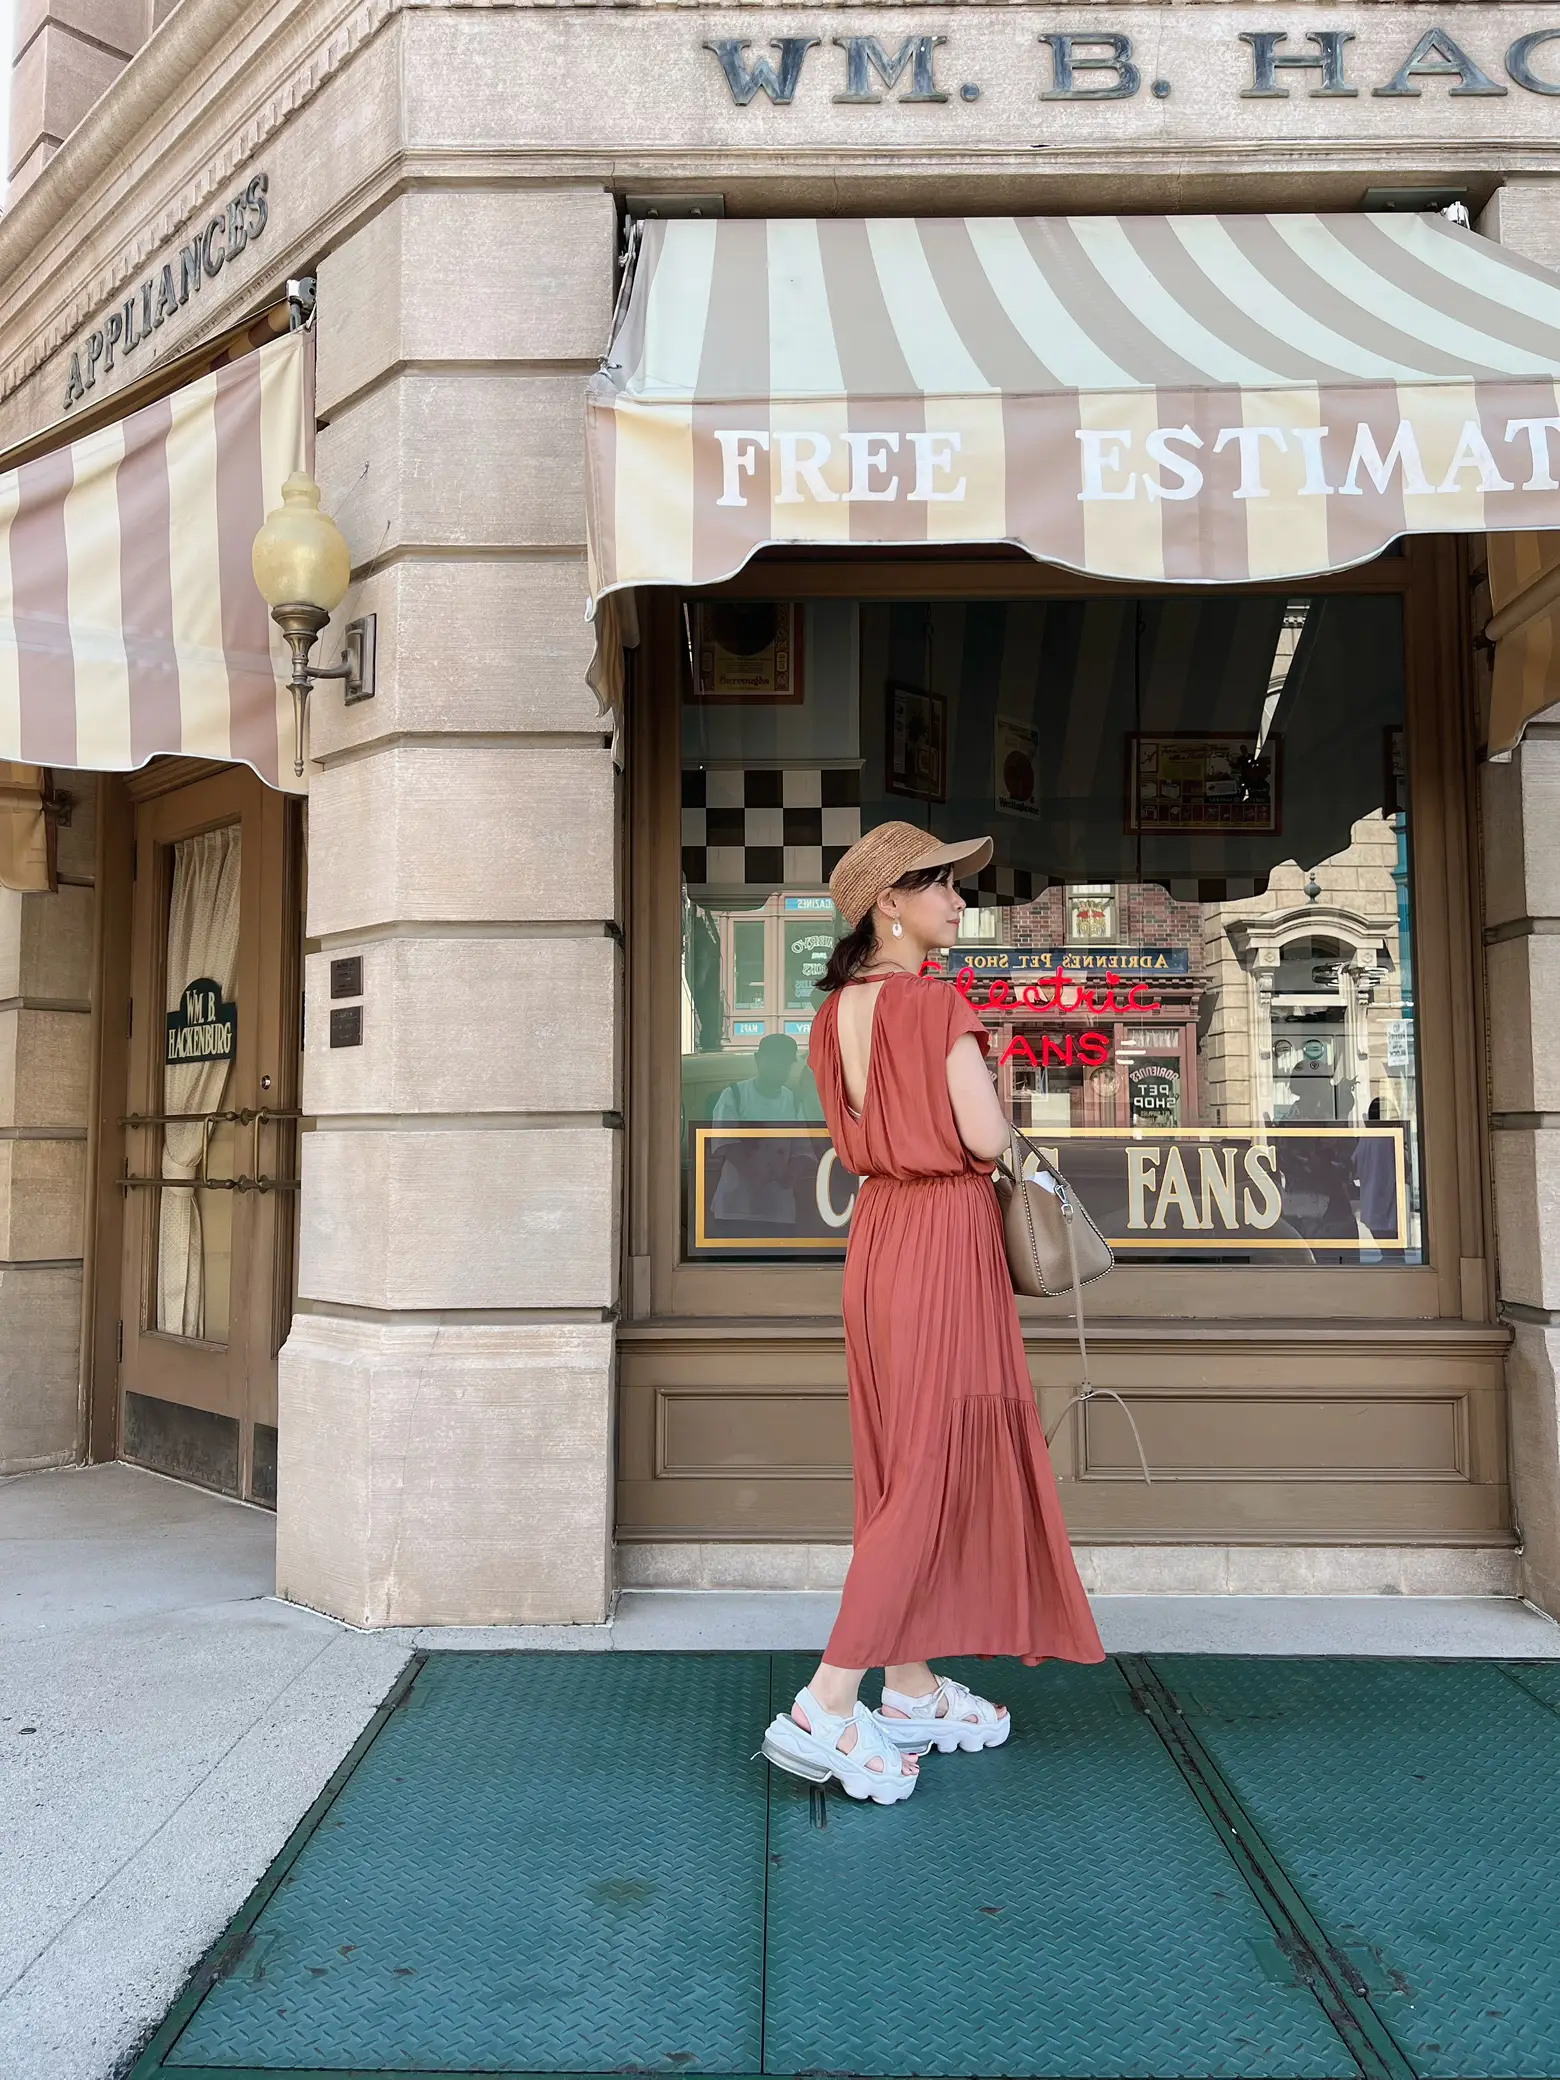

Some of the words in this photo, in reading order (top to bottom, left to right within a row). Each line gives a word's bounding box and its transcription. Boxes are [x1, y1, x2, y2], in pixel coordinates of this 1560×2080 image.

[703, 34, 981, 106] WM.
[1039, 31, 1172, 101] B.
[62, 172, 270, 409] APPLIANCES
[714, 427, 969, 507] FREE
[1075, 416, 1560, 502] ESTIMAT
[168, 1022, 232, 1059] HACKENBURG
[994, 1032, 1109, 1067] ANS
[1125, 1145, 1282, 1230] FANS
